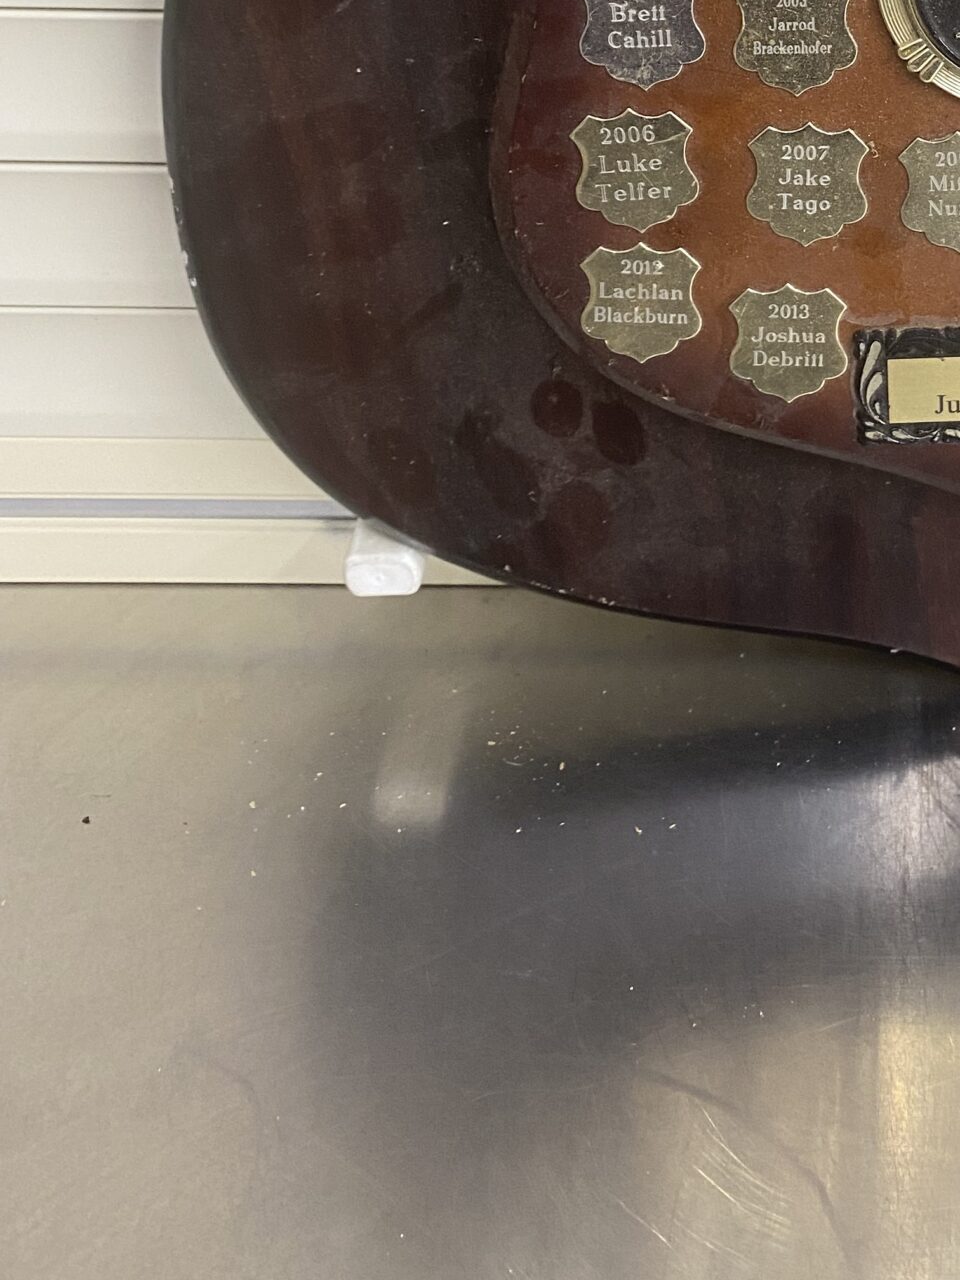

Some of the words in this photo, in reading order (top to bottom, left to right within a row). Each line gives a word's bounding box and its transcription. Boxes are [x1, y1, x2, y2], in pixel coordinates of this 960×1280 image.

[609, 1, 666, 23] Brett
[768, 17, 817, 32] Jarrod
[608, 30, 672, 49] Cahill
[752, 41, 834, 56] Brackenhofer
[600, 125, 656, 145] 2006
[781, 145, 830, 160] 2007
[598, 154, 663, 174] Luke
[778, 170, 832, 186] Jake
[594, 183, 672, 203] Telfer
[776, 193, 832, 215] Tago
[620, 260, 664, 275] 2012
[599, 282, 684, 301] Lachlan
[593, 306, 688, 325] Blackburn
[768, 304, 810, 319] 2013
[751, 327, 825, 344] Joshua
